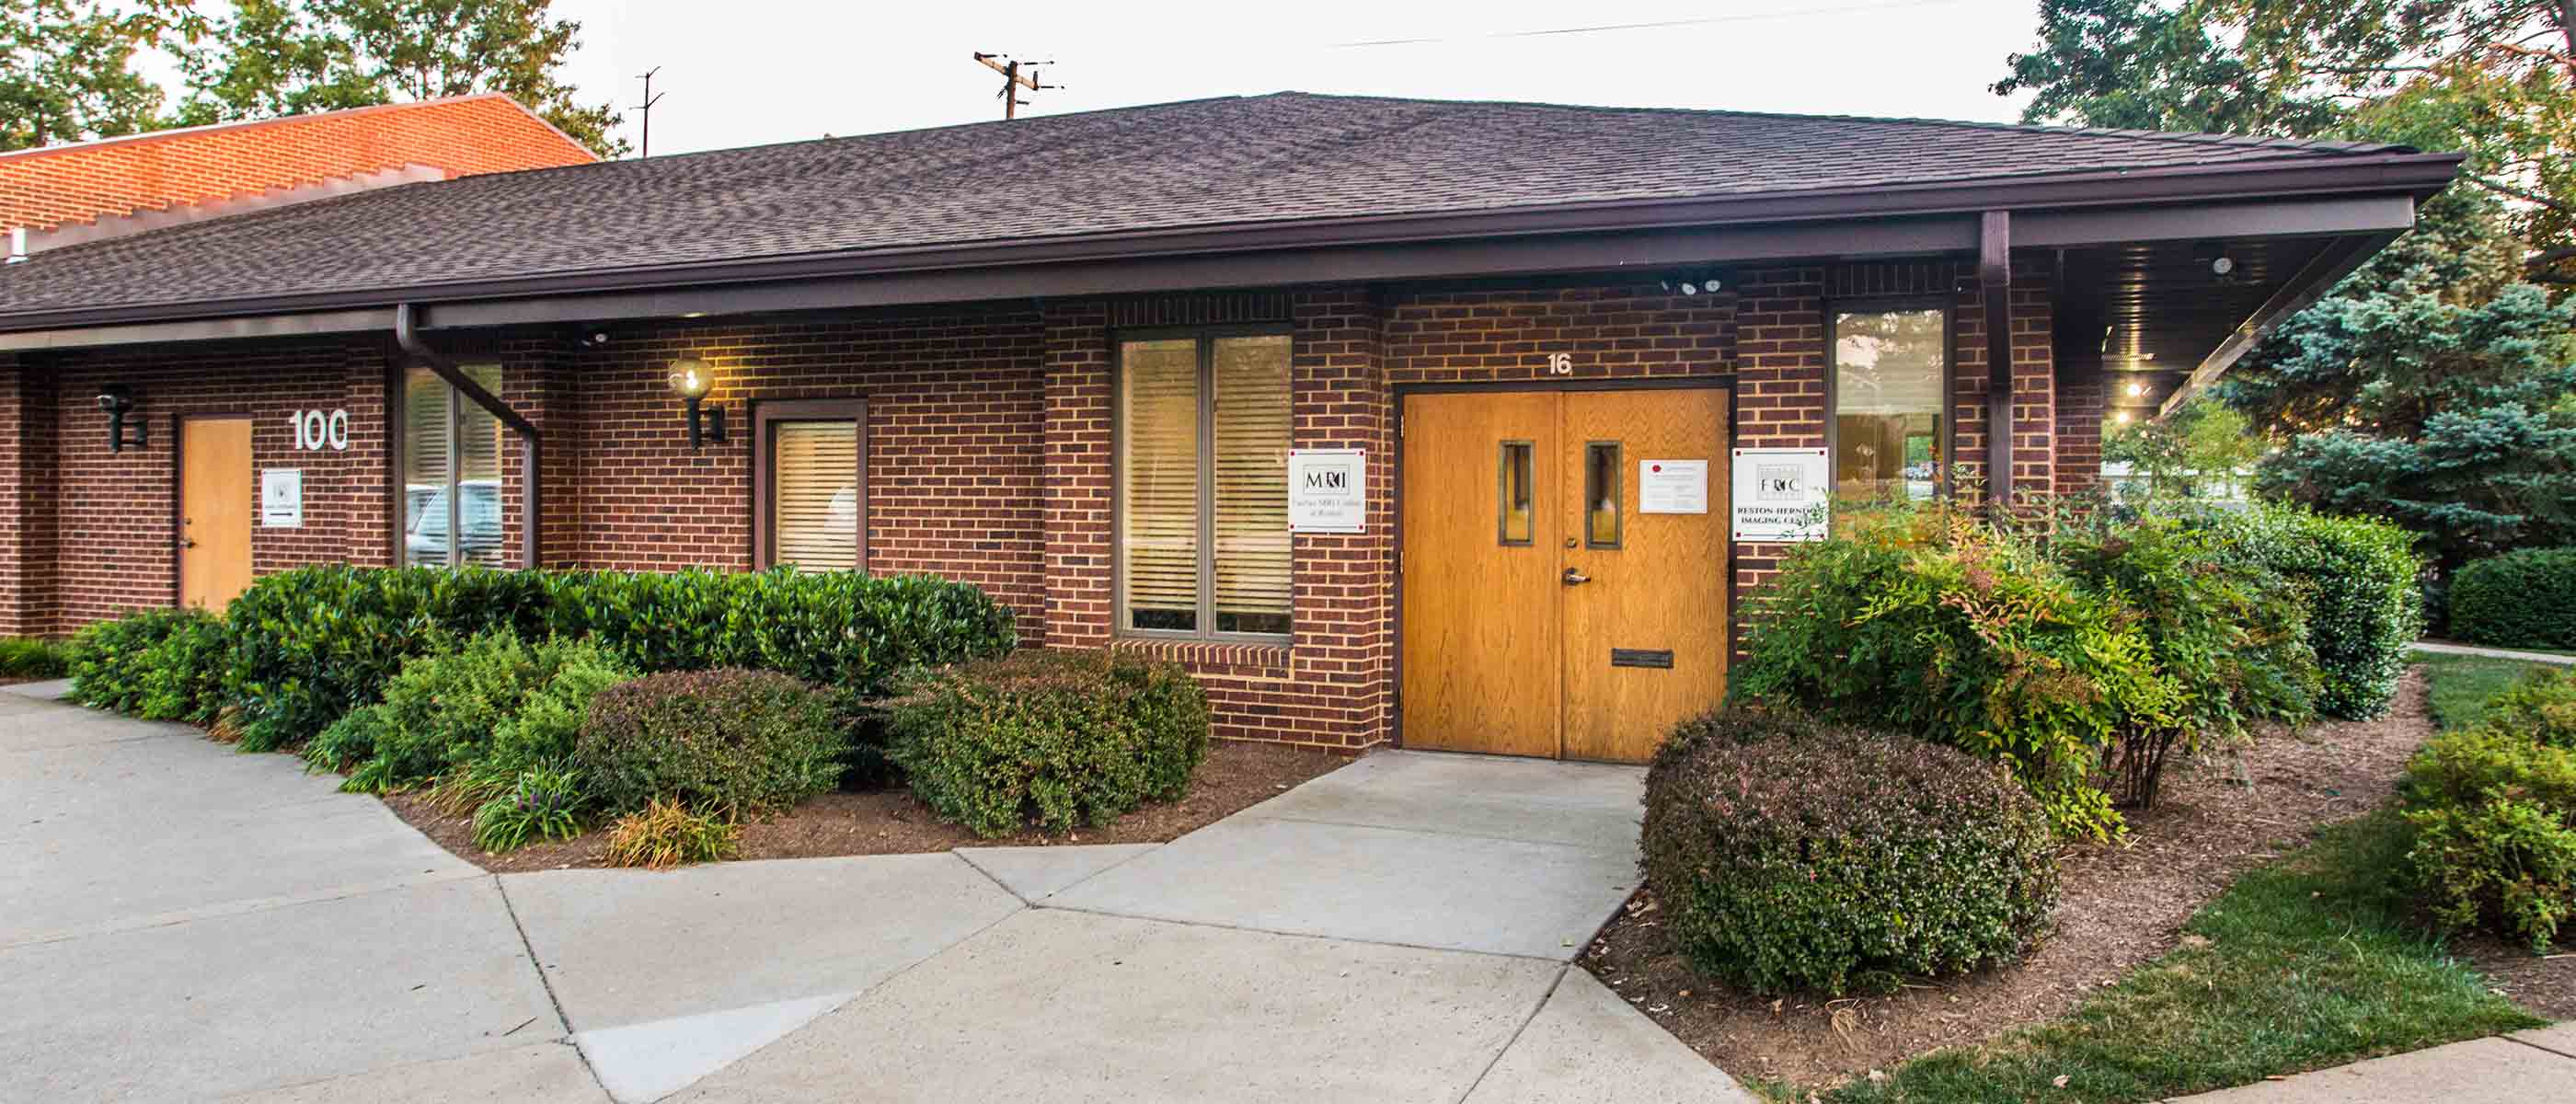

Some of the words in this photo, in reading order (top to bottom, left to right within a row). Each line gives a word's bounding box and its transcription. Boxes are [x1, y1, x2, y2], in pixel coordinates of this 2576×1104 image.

[1547, 352, 1572, 375] 16
[288, 408, 349, 451] 100
[1741, 516, 1782, 524] IMAGING
